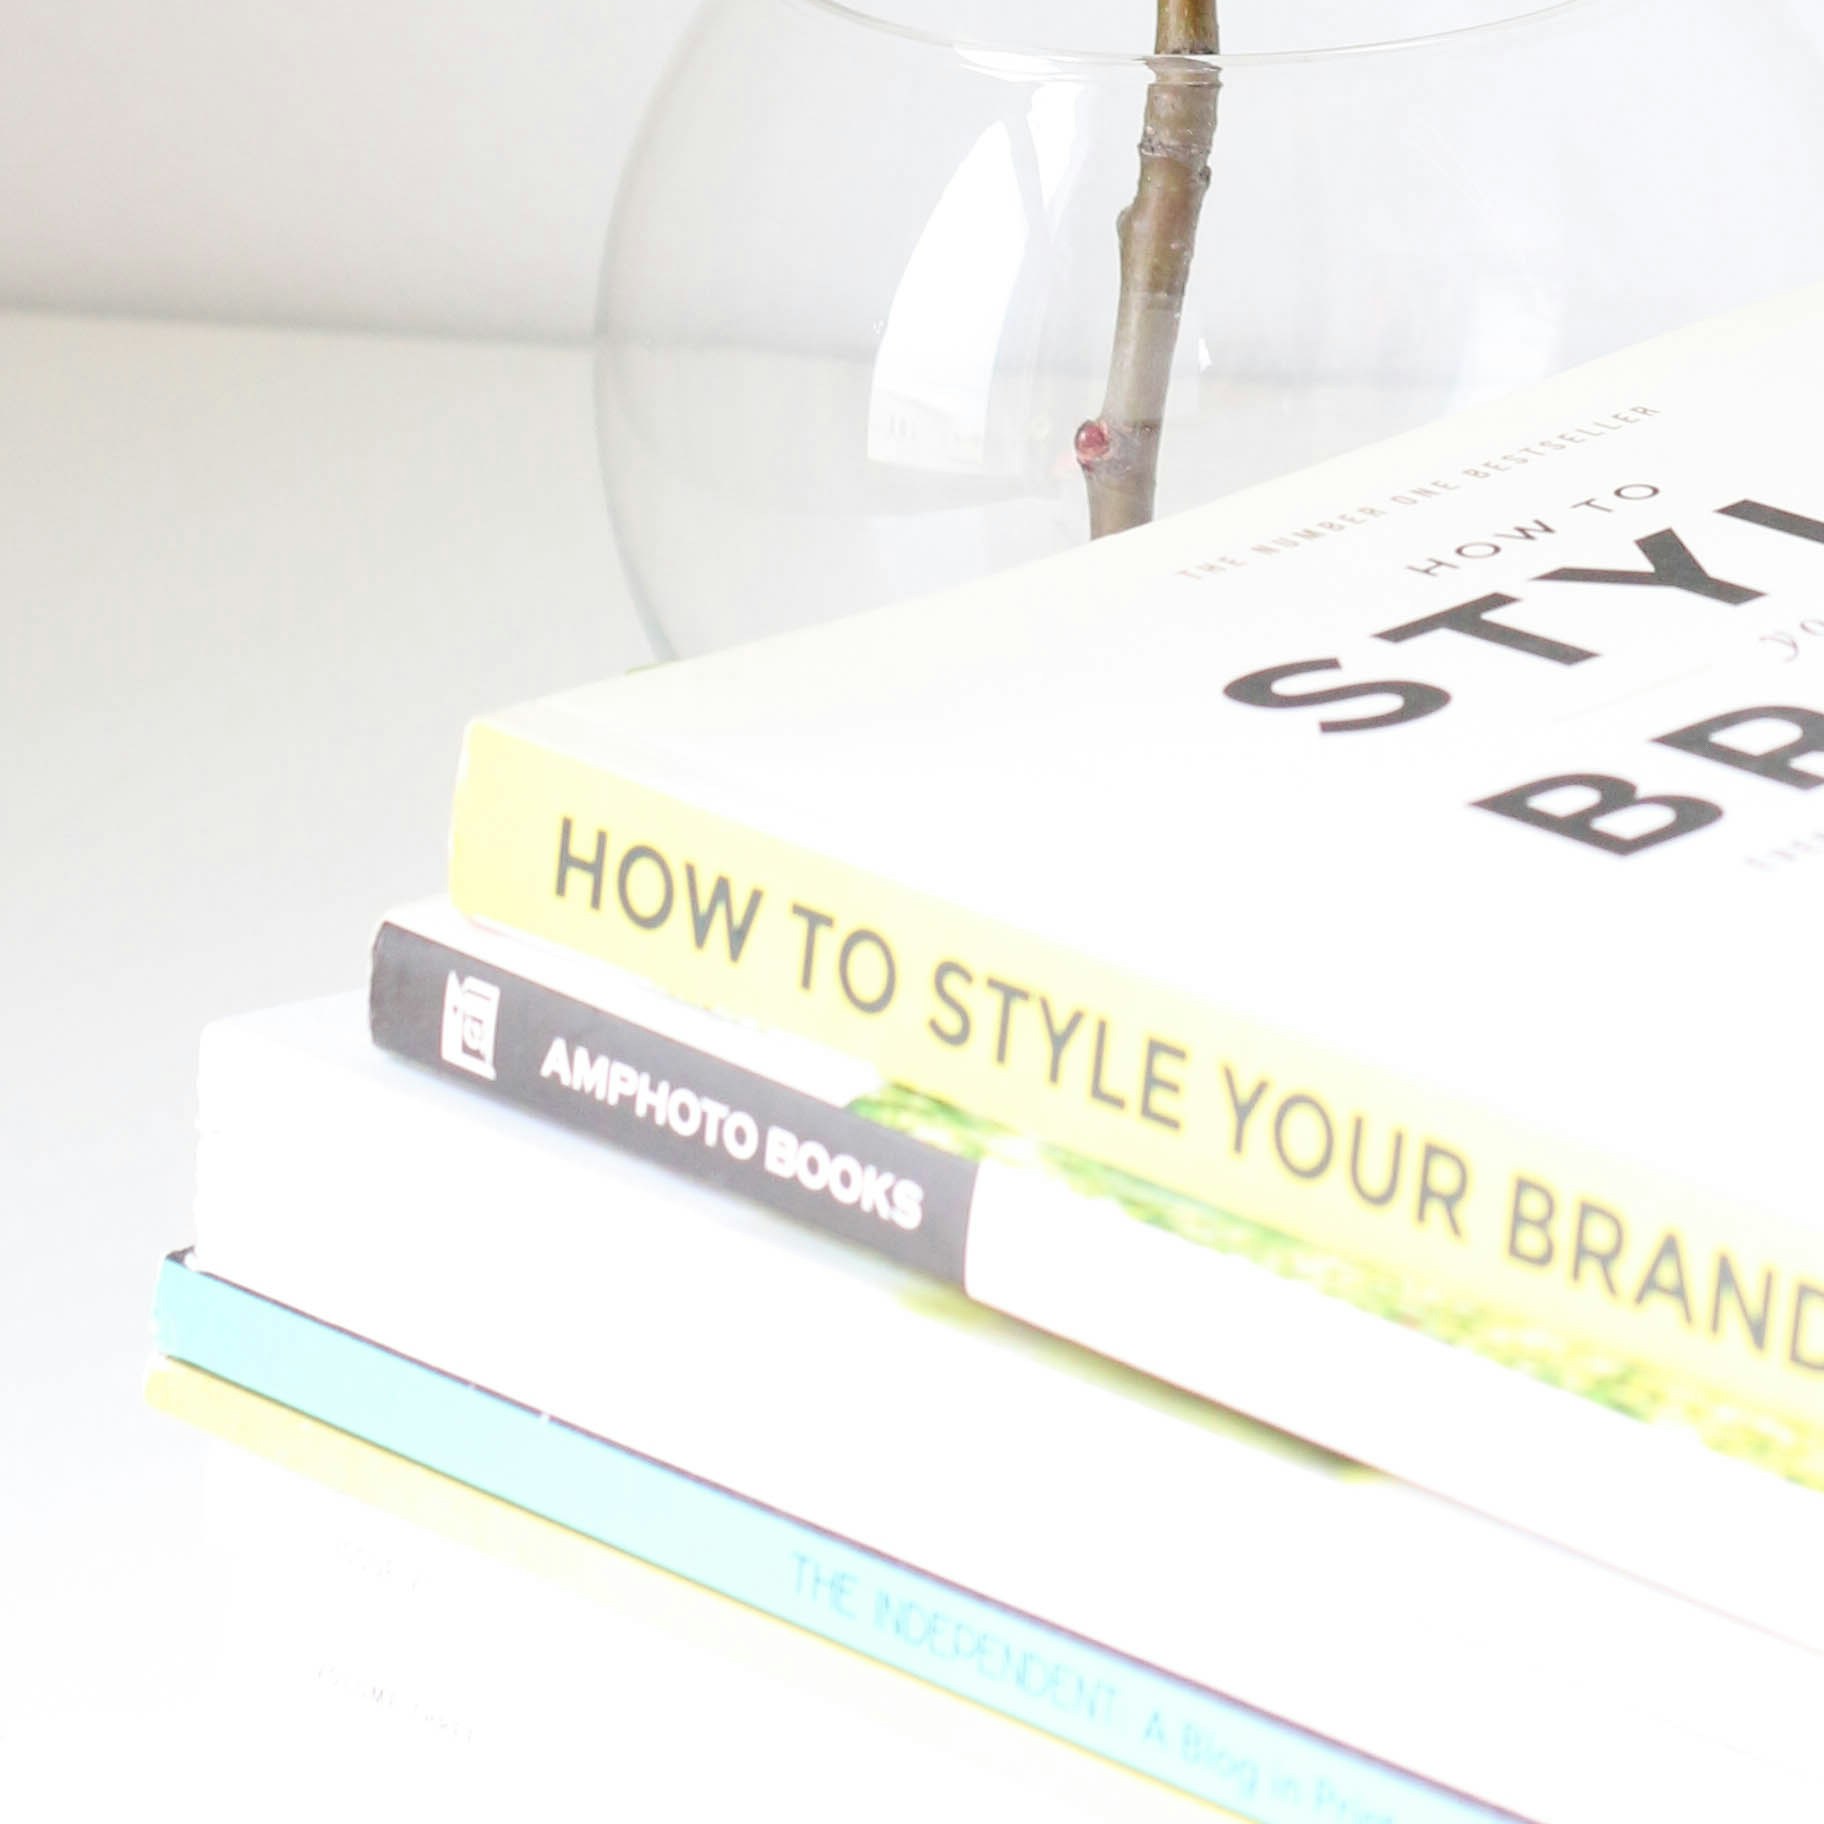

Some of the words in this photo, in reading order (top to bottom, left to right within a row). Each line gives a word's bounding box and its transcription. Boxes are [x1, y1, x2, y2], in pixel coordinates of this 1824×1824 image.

[1173, 554, 1248, 583] THE
[1250, 504, 1388, 559] NUMBER
[1389, 478, 1461, 507] ONE
[1461, 403, 1662, 480] BESTSELLER
[1405, 517, 1557, 578] HOW
[1570, 482, 1661, 515] TO
[554, 816, 765, 965] HOW
[791, 902, 898, 1015] TO
[928, 959, 1190, 1133] STYLE
[1219, 1062, 1472, 1241] YOUR
[540, 1037, 759, 1160] AMPHOTO
[764, 1125, 925, 1230] BOOKS
[791, 1551, 858, 1620] THE
[1142, 1709, 1168, 1748] A
[1181, 1719, 1259, 1798] Blog
